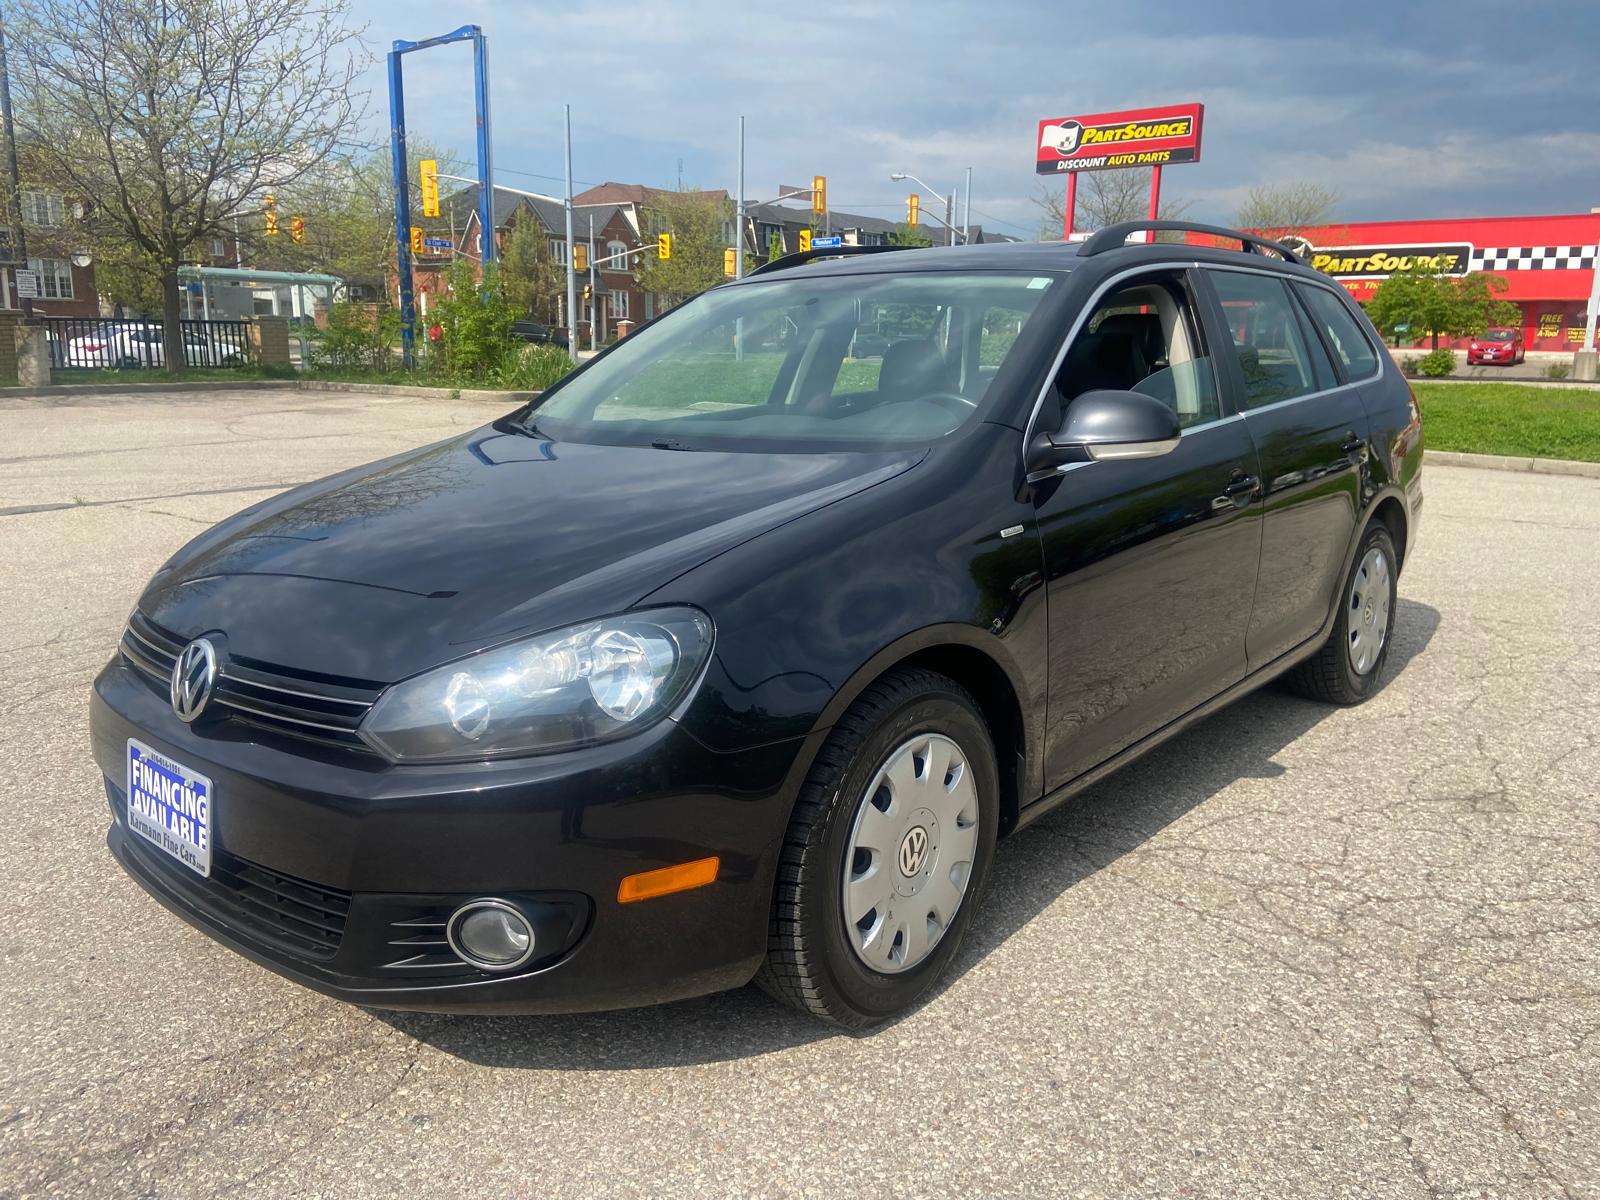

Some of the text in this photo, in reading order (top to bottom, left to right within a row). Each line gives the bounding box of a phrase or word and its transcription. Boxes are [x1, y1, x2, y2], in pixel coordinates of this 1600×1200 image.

[1057, 151, 1170, 170] DISCOUNT AUTO PARTS
[1540, 313, 1563, 322] FREE
[132, 758, 206, 824] FINANCING
[130, 811, 162, 844] Karmann
[163, 832, 179, 856] Fine
[133, 788, 206, 851] AVAILABLE
